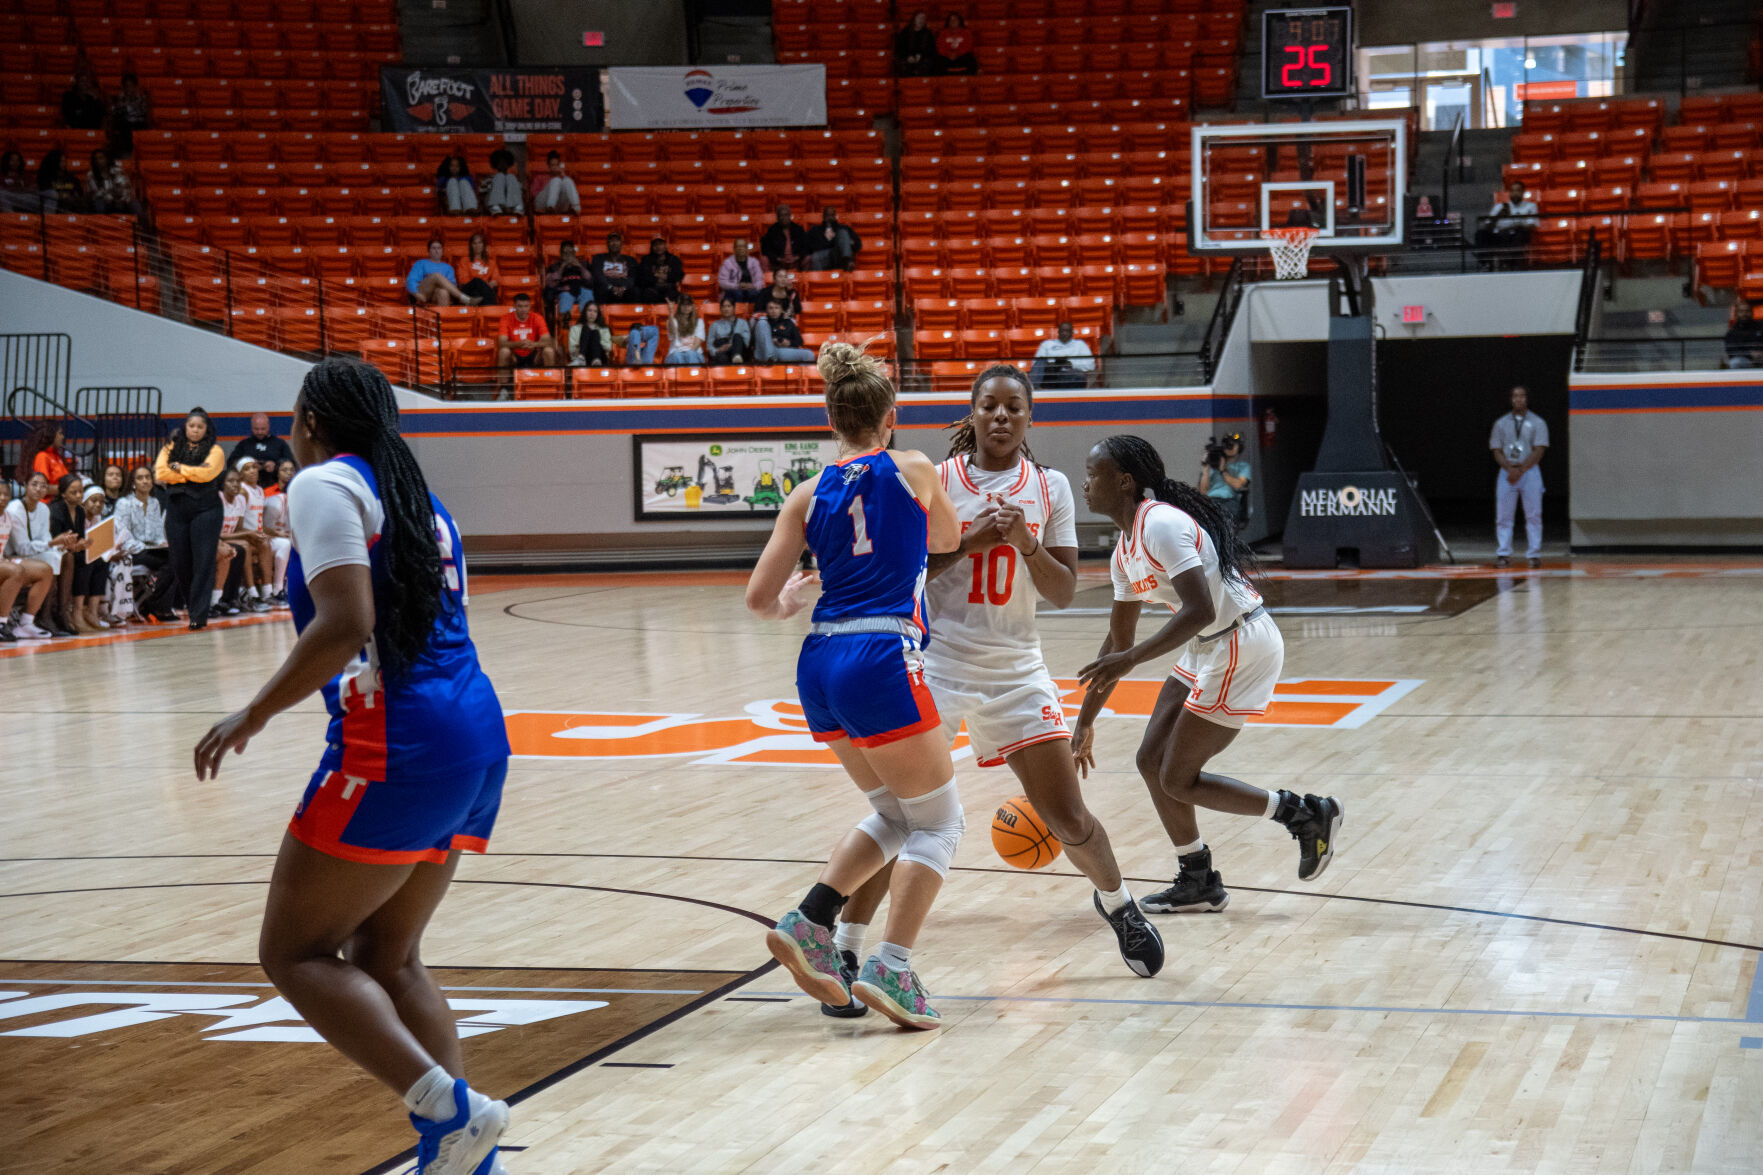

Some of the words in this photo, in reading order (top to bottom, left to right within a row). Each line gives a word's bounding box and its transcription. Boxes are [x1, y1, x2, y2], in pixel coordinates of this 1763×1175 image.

[1281, 45, 1331, 87] 25
[489, 75, 514, 95] ALL
[517, 75, 566, 95] THINGS
[493, 98, 531, 118] GAME
[727, 447, 747, 455] JOHN
[748, 446, 774, 454] DEERE
[1301, 486, 1397, 507] MEMORIAL
[1301, 502, 1396, 516] HERMANN
[848, 494, 873, 556] 1
[968, 545, 1017, 606] 10
